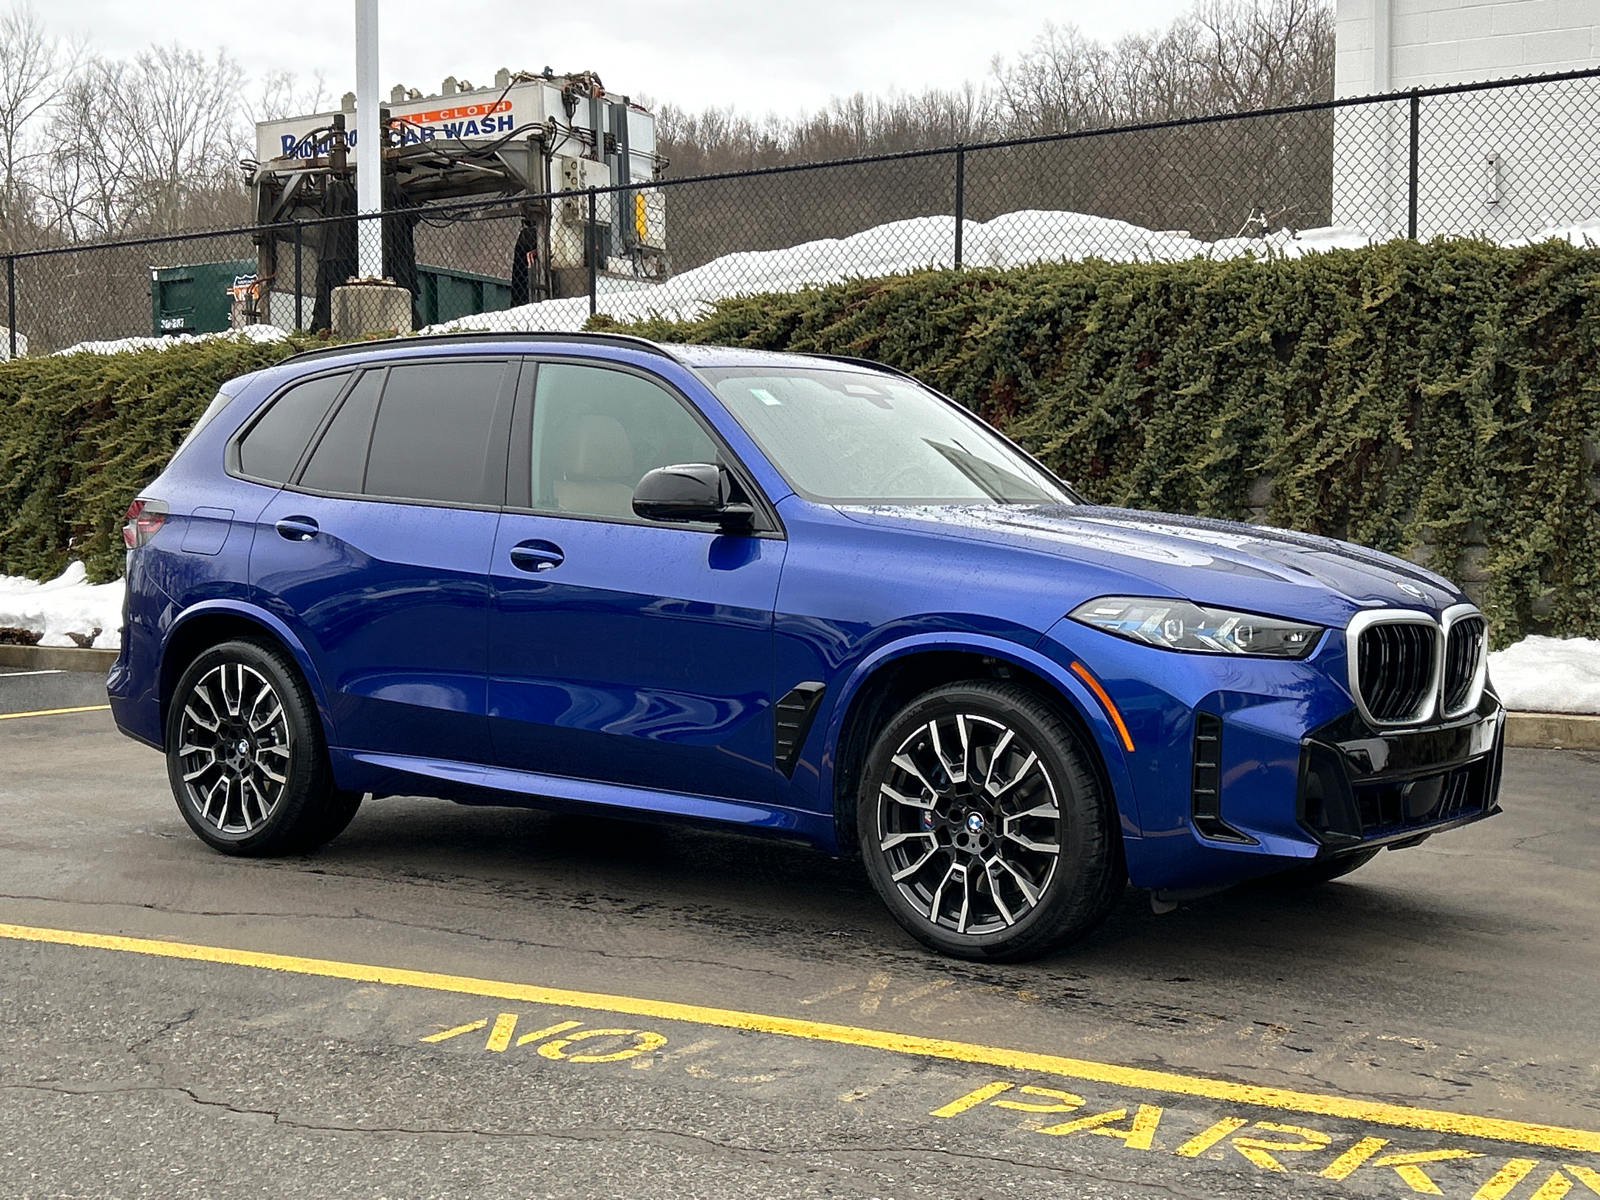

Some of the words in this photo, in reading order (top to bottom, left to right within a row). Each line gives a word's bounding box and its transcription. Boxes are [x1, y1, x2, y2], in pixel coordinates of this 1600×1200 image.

[440, 101, 506, 119] CLOTH
[389, 126, 436, 147] CAR
[443, 115, 514, 139] WASH
[419, 1012, 668, 1063] NO
